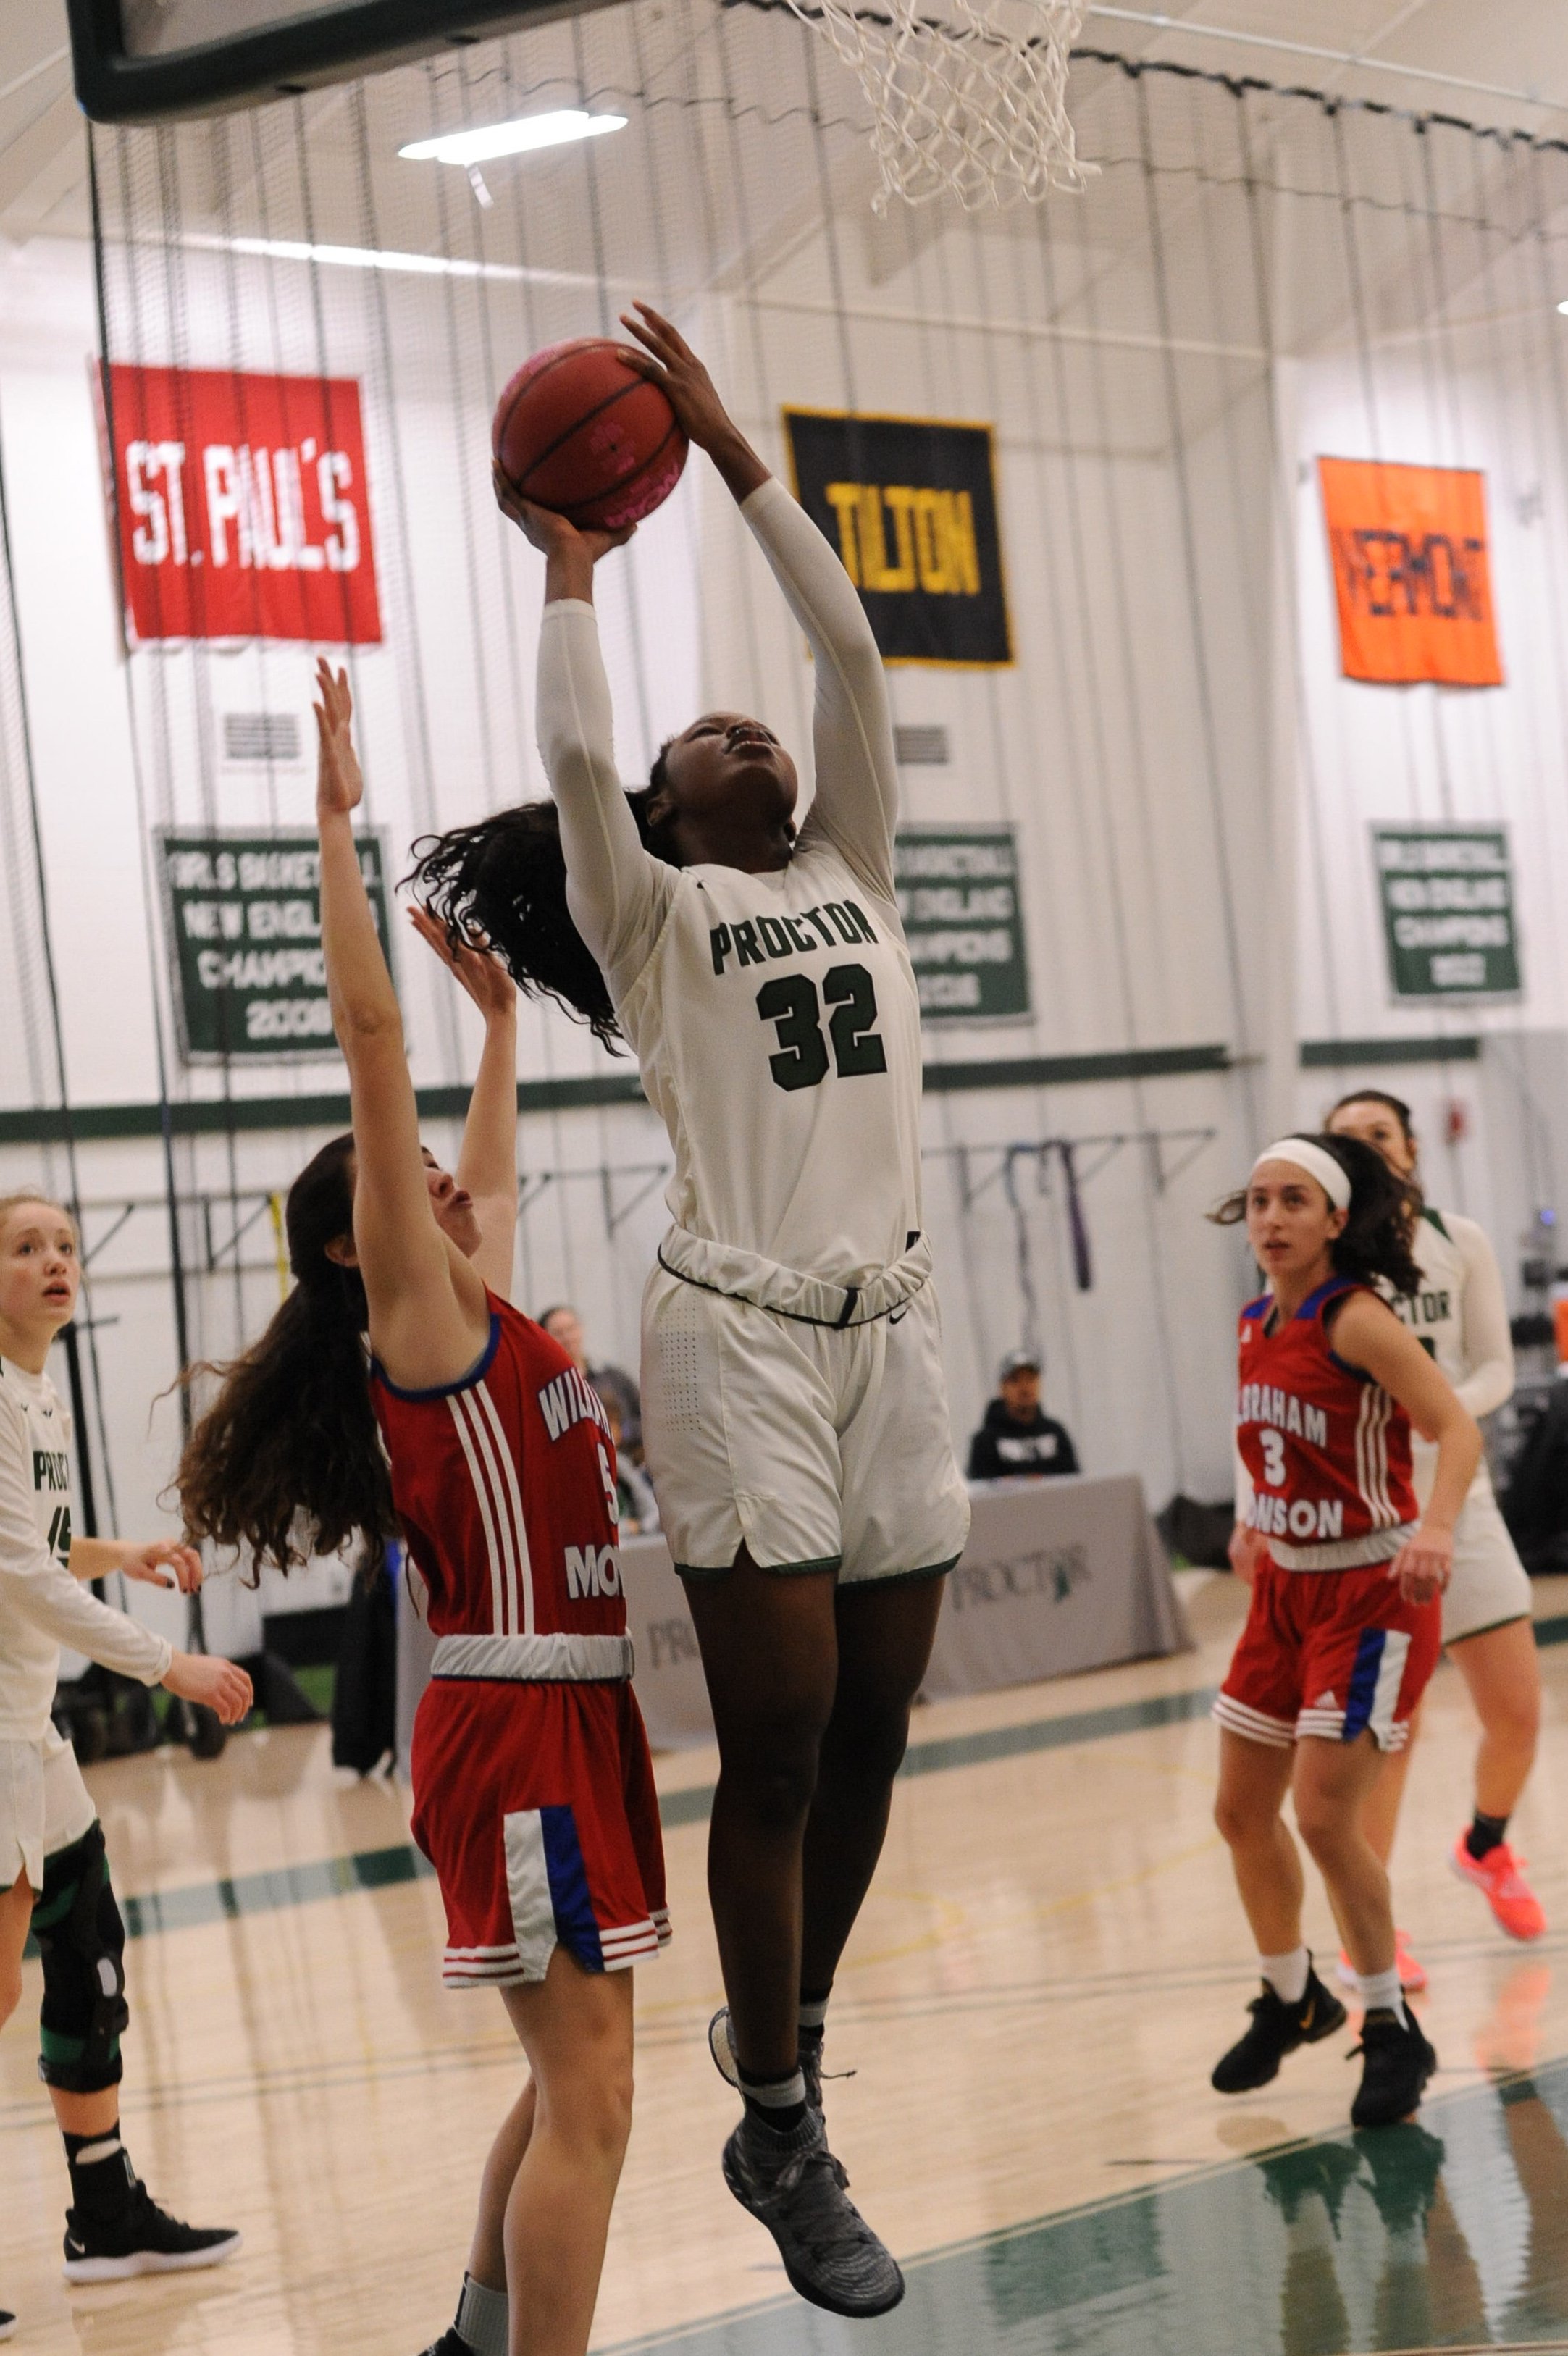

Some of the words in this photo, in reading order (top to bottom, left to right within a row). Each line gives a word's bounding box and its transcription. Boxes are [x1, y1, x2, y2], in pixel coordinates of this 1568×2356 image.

[825, 481, 981, 598] TILTON
[755, 963, 888, 1093] 32
[1259, 1428, 1286, 1487] 3
